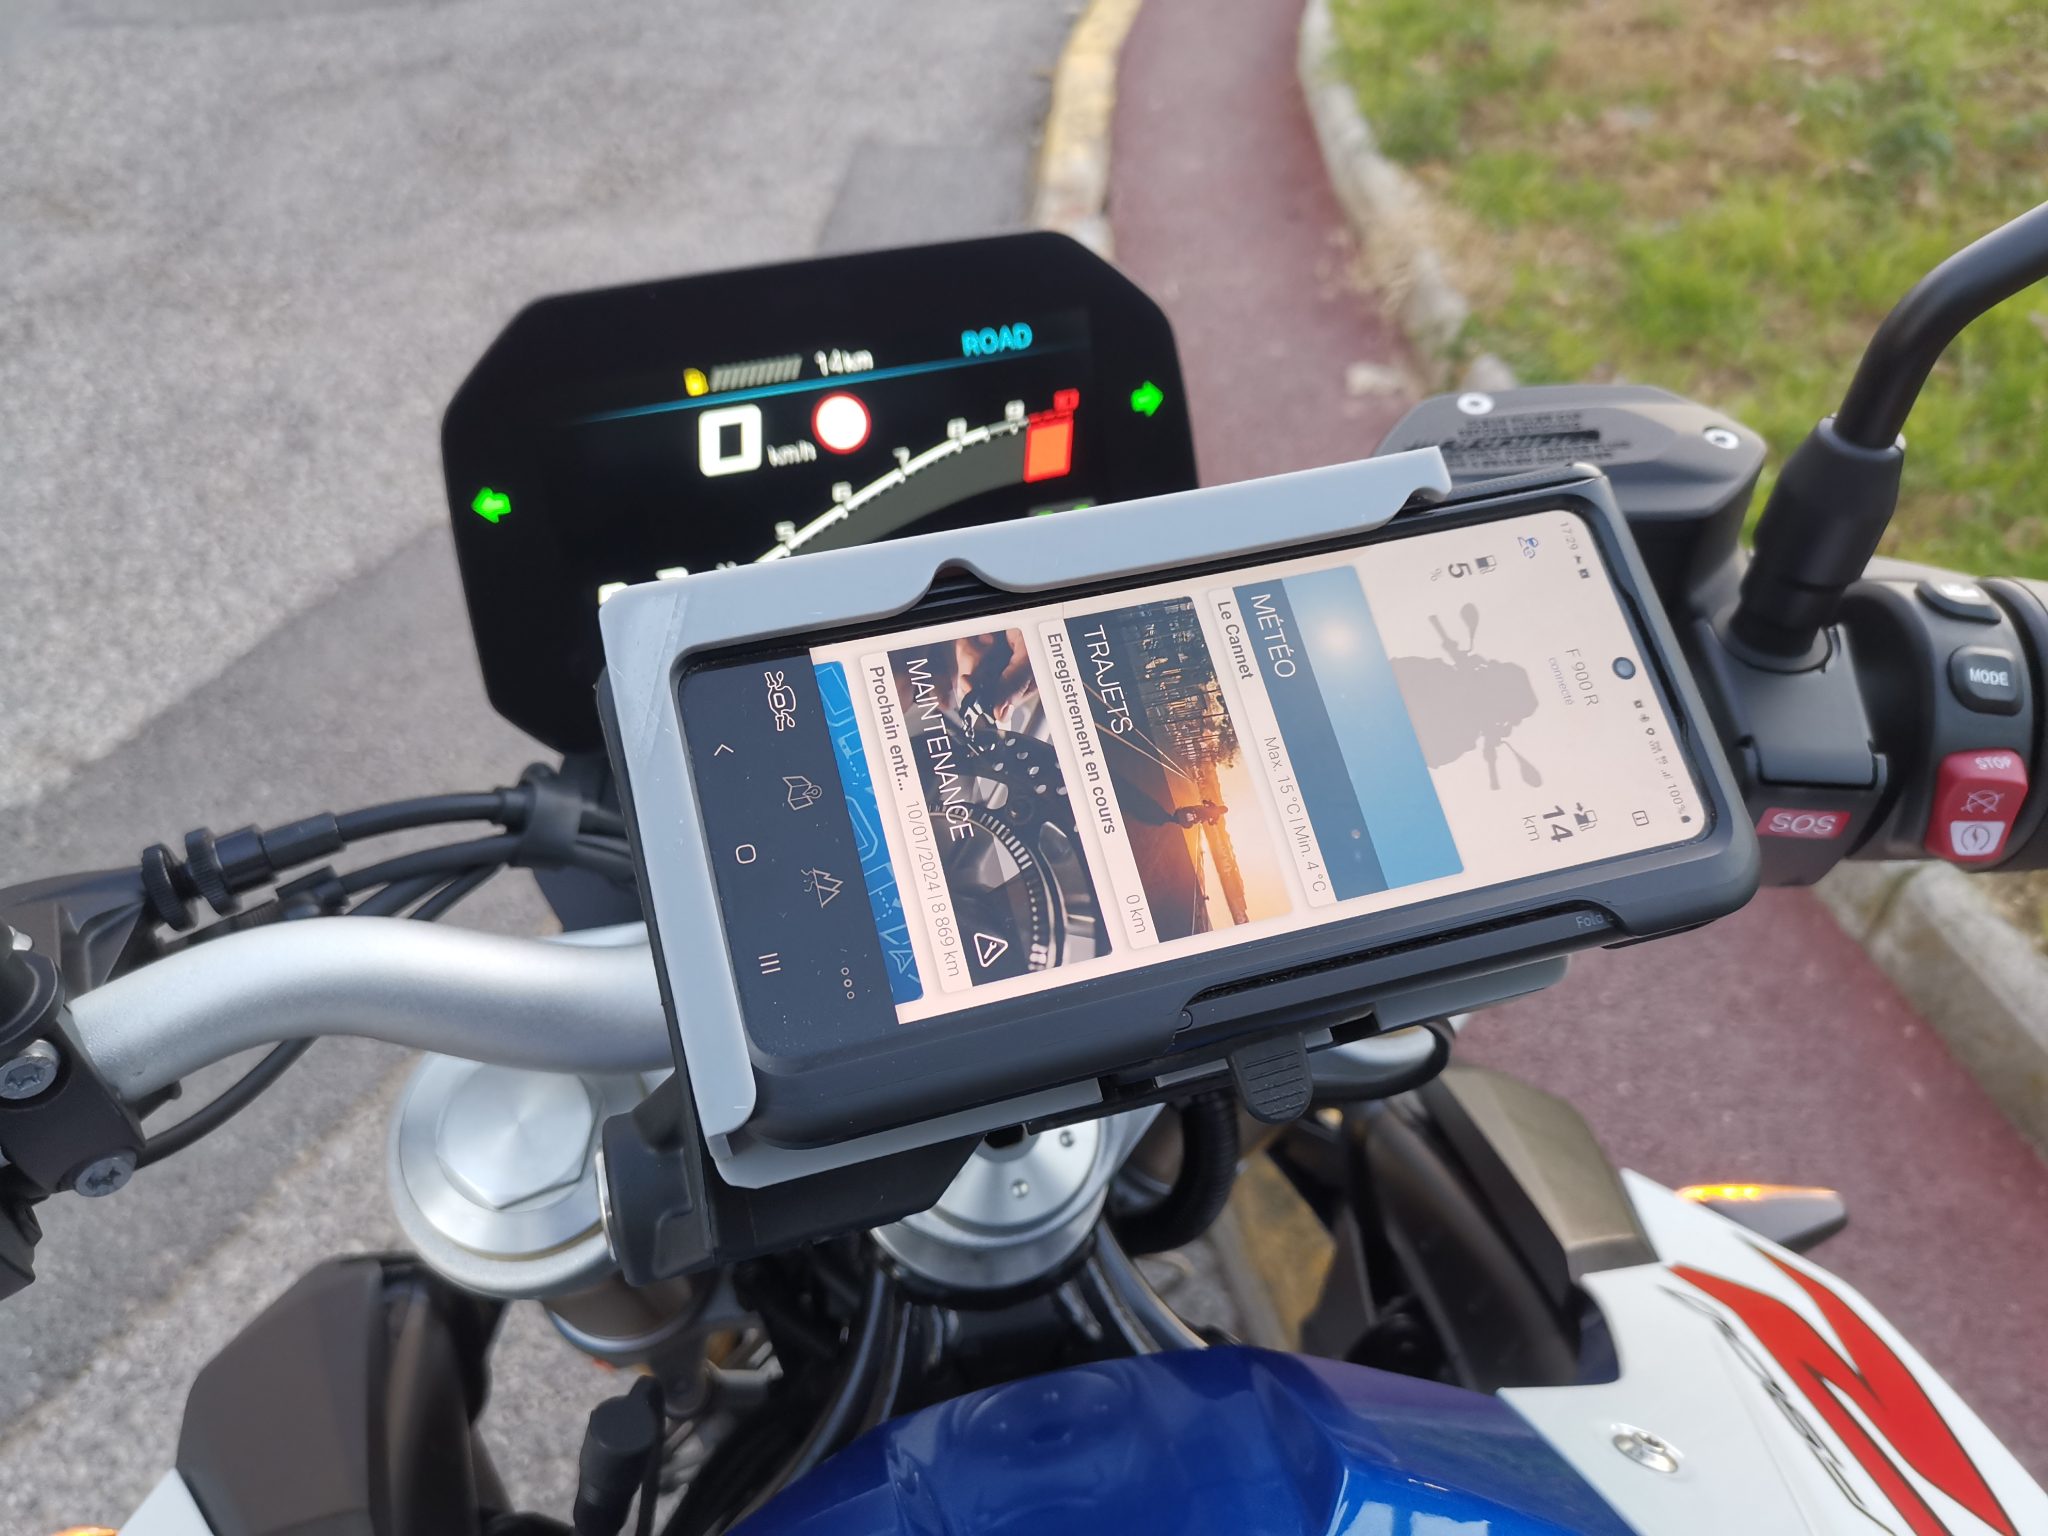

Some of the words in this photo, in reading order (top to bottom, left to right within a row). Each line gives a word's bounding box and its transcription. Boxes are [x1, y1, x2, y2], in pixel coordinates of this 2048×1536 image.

[961, 322, 1033, 357] ROAD
[698, 404, 763, 477] 0
[1448, 562, 1472, 578] 5
[1218, 601, 1232, 620] Le
[1225, 623, 1254, 680] Cannet
[1251, 594, 1296, 678] MÉTÉO
[1565, 648, 1581, 658] F
[1084, 624, 1133, 735] TRAJETS
[1571, 662, 1593, 692] 900
[1969, 667, 2010, 687] MODE
[869, 665, 897, 740] Prochain
[1584, 694, 1599, 706] R
[906, 658, 975, 842] MAINTENANCE
[1047, 632, 1095, 757] Enregistrement
[1085, 760, 1101, 782] en
[1093, 786, 1116, 835] cours
[1975, 755, 2012, 770] STOP
[1264, 736, 1283, 772] Max.
[1277, 776, 1295, 795] 15
[1292, 824, 1312, 857] Min.
[1307, 861, 1320, 871] 4
[1522, 815, 1541, 842] km
[1542, 805, 1574, 843] 14
[1767, 812, 1838, 834] SOS
[905, 800, 941, 893] 10/01/2024
[944, 951, 960, 977] km
[1126, 894, 1140, 905] 0
[1130, 908, 1146, 934] km
